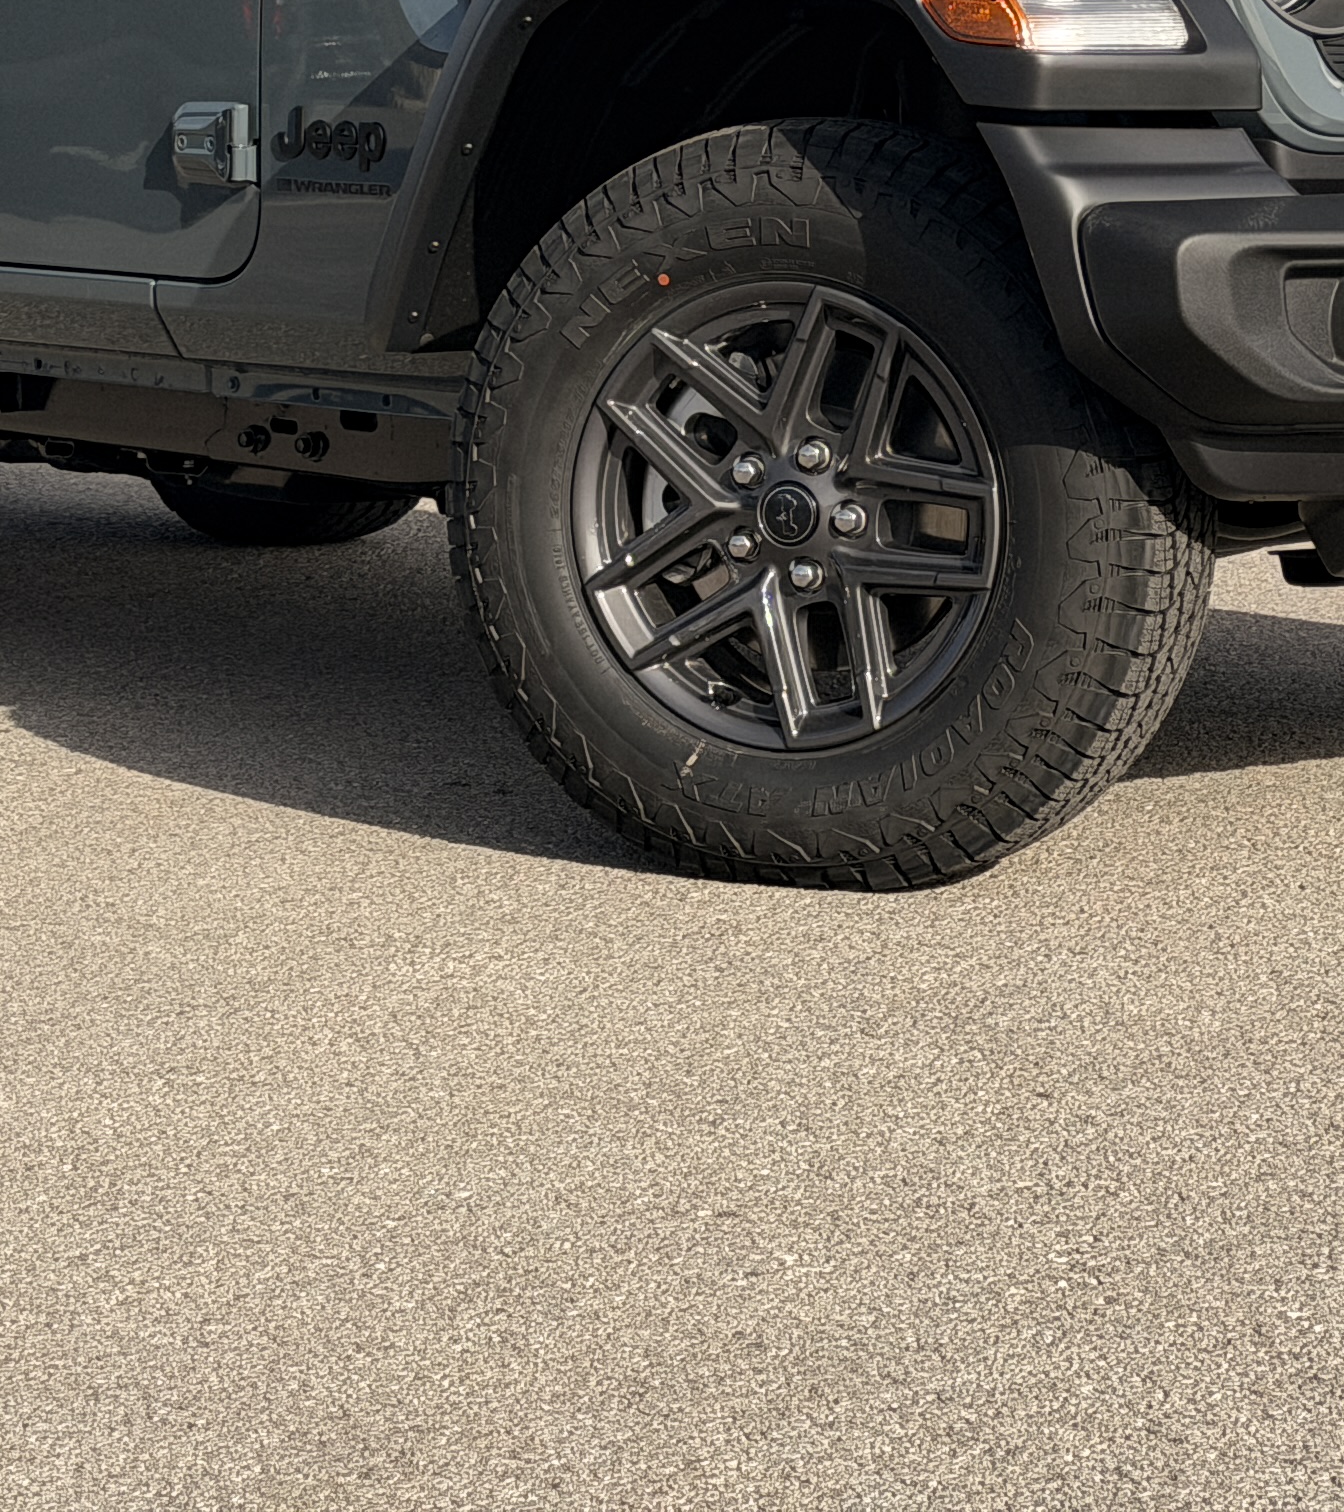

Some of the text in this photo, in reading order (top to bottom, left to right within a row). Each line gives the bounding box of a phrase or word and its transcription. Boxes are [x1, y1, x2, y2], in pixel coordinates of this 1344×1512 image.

[270, 105, 387, 172] Jeep
[292, 178, 392, 196] WRANGLER
[560, 216, 810, 349] NEXEN
[811, 617, 1034, 817] ROADIAN
